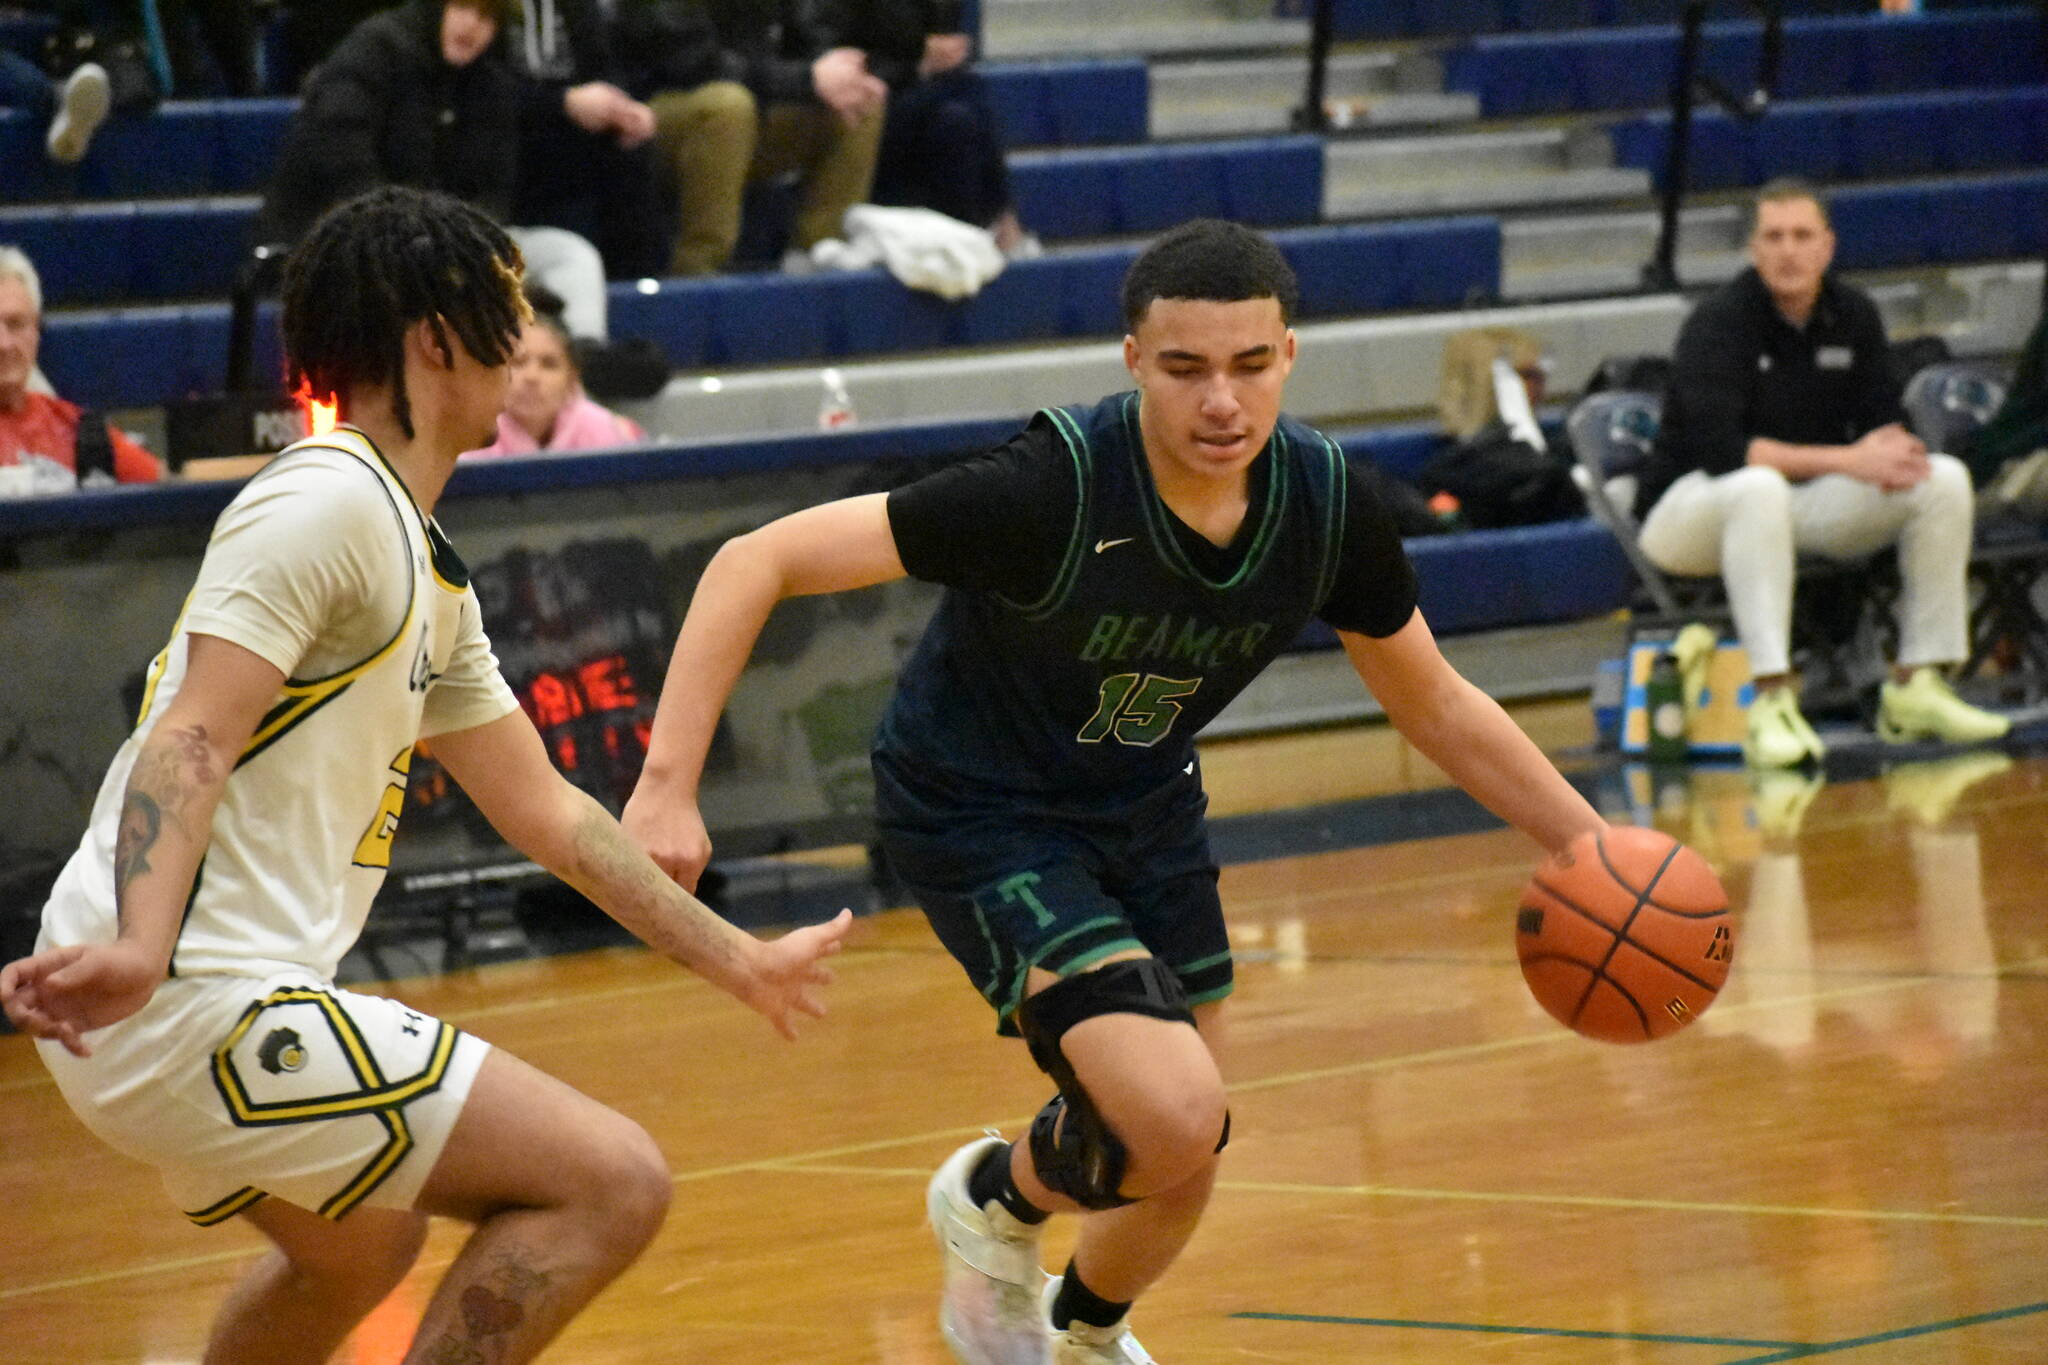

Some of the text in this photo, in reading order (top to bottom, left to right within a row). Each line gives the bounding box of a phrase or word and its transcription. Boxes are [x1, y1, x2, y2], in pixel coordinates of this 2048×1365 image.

[1078, 613, 1273, 667] BEAMER
[1077, 672, 1203, 747] 15
[997, 871, 1057, 929] T
